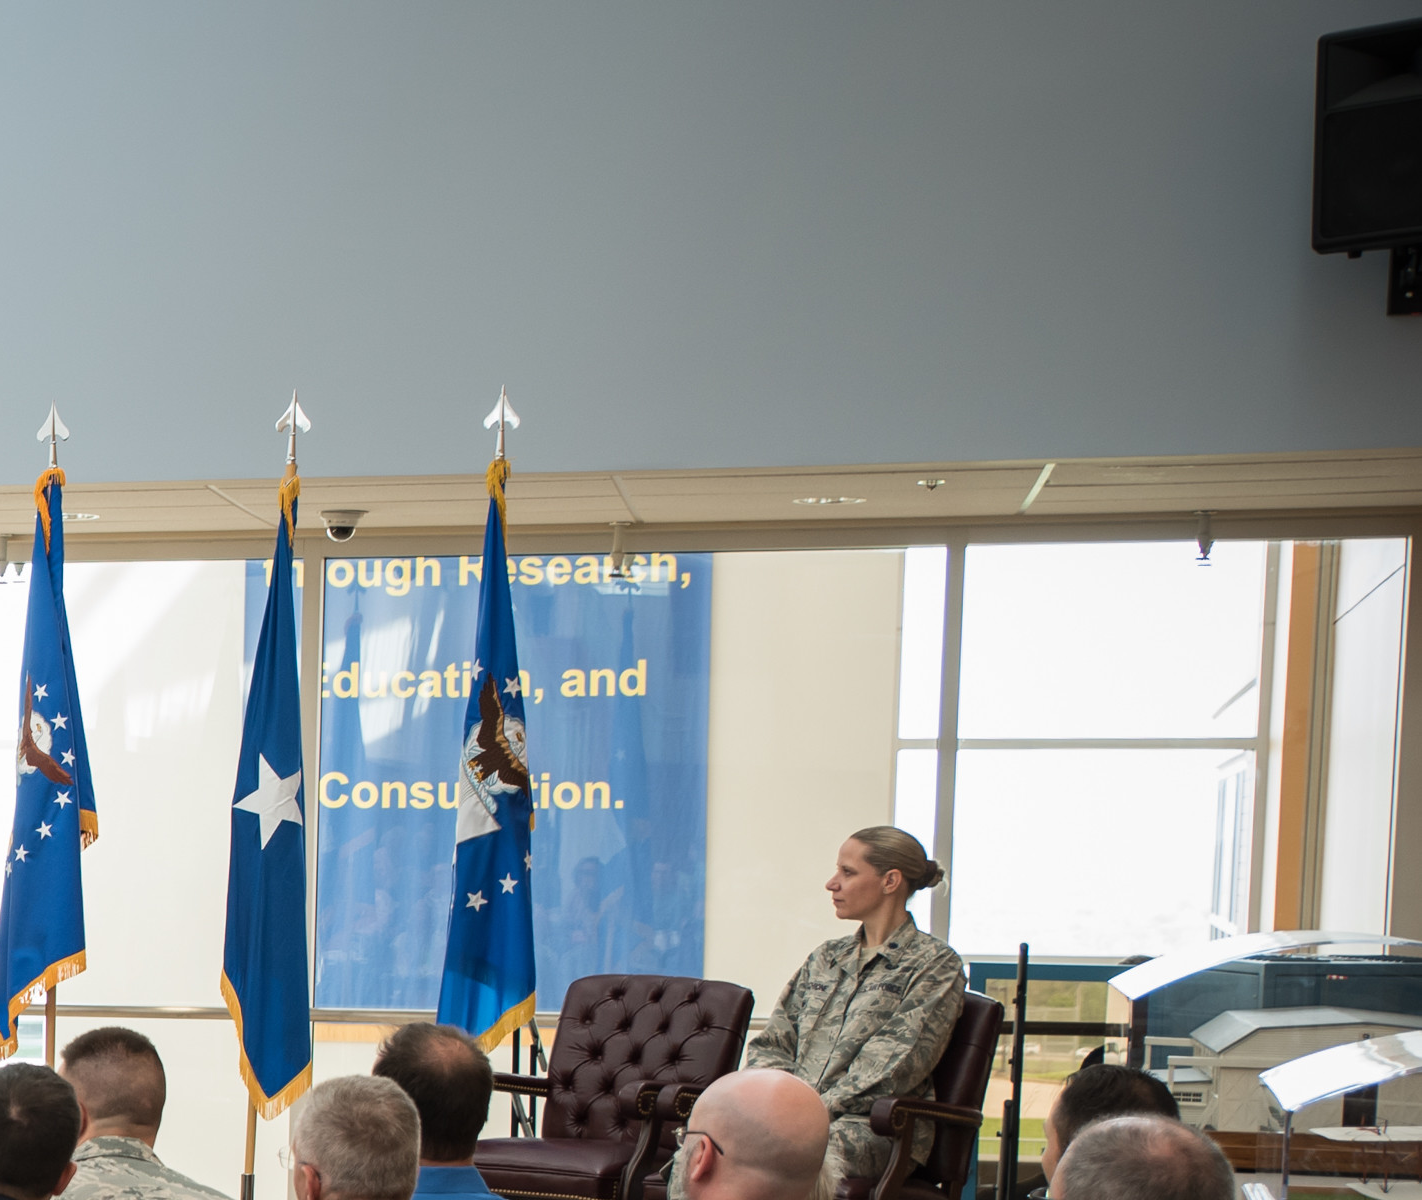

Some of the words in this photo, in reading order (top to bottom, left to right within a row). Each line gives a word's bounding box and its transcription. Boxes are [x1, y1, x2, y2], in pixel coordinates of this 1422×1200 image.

[263, 556, 441, 597] tough
[321, 660, 544, 704] ducati,
[560, 659, 647, 697] and
